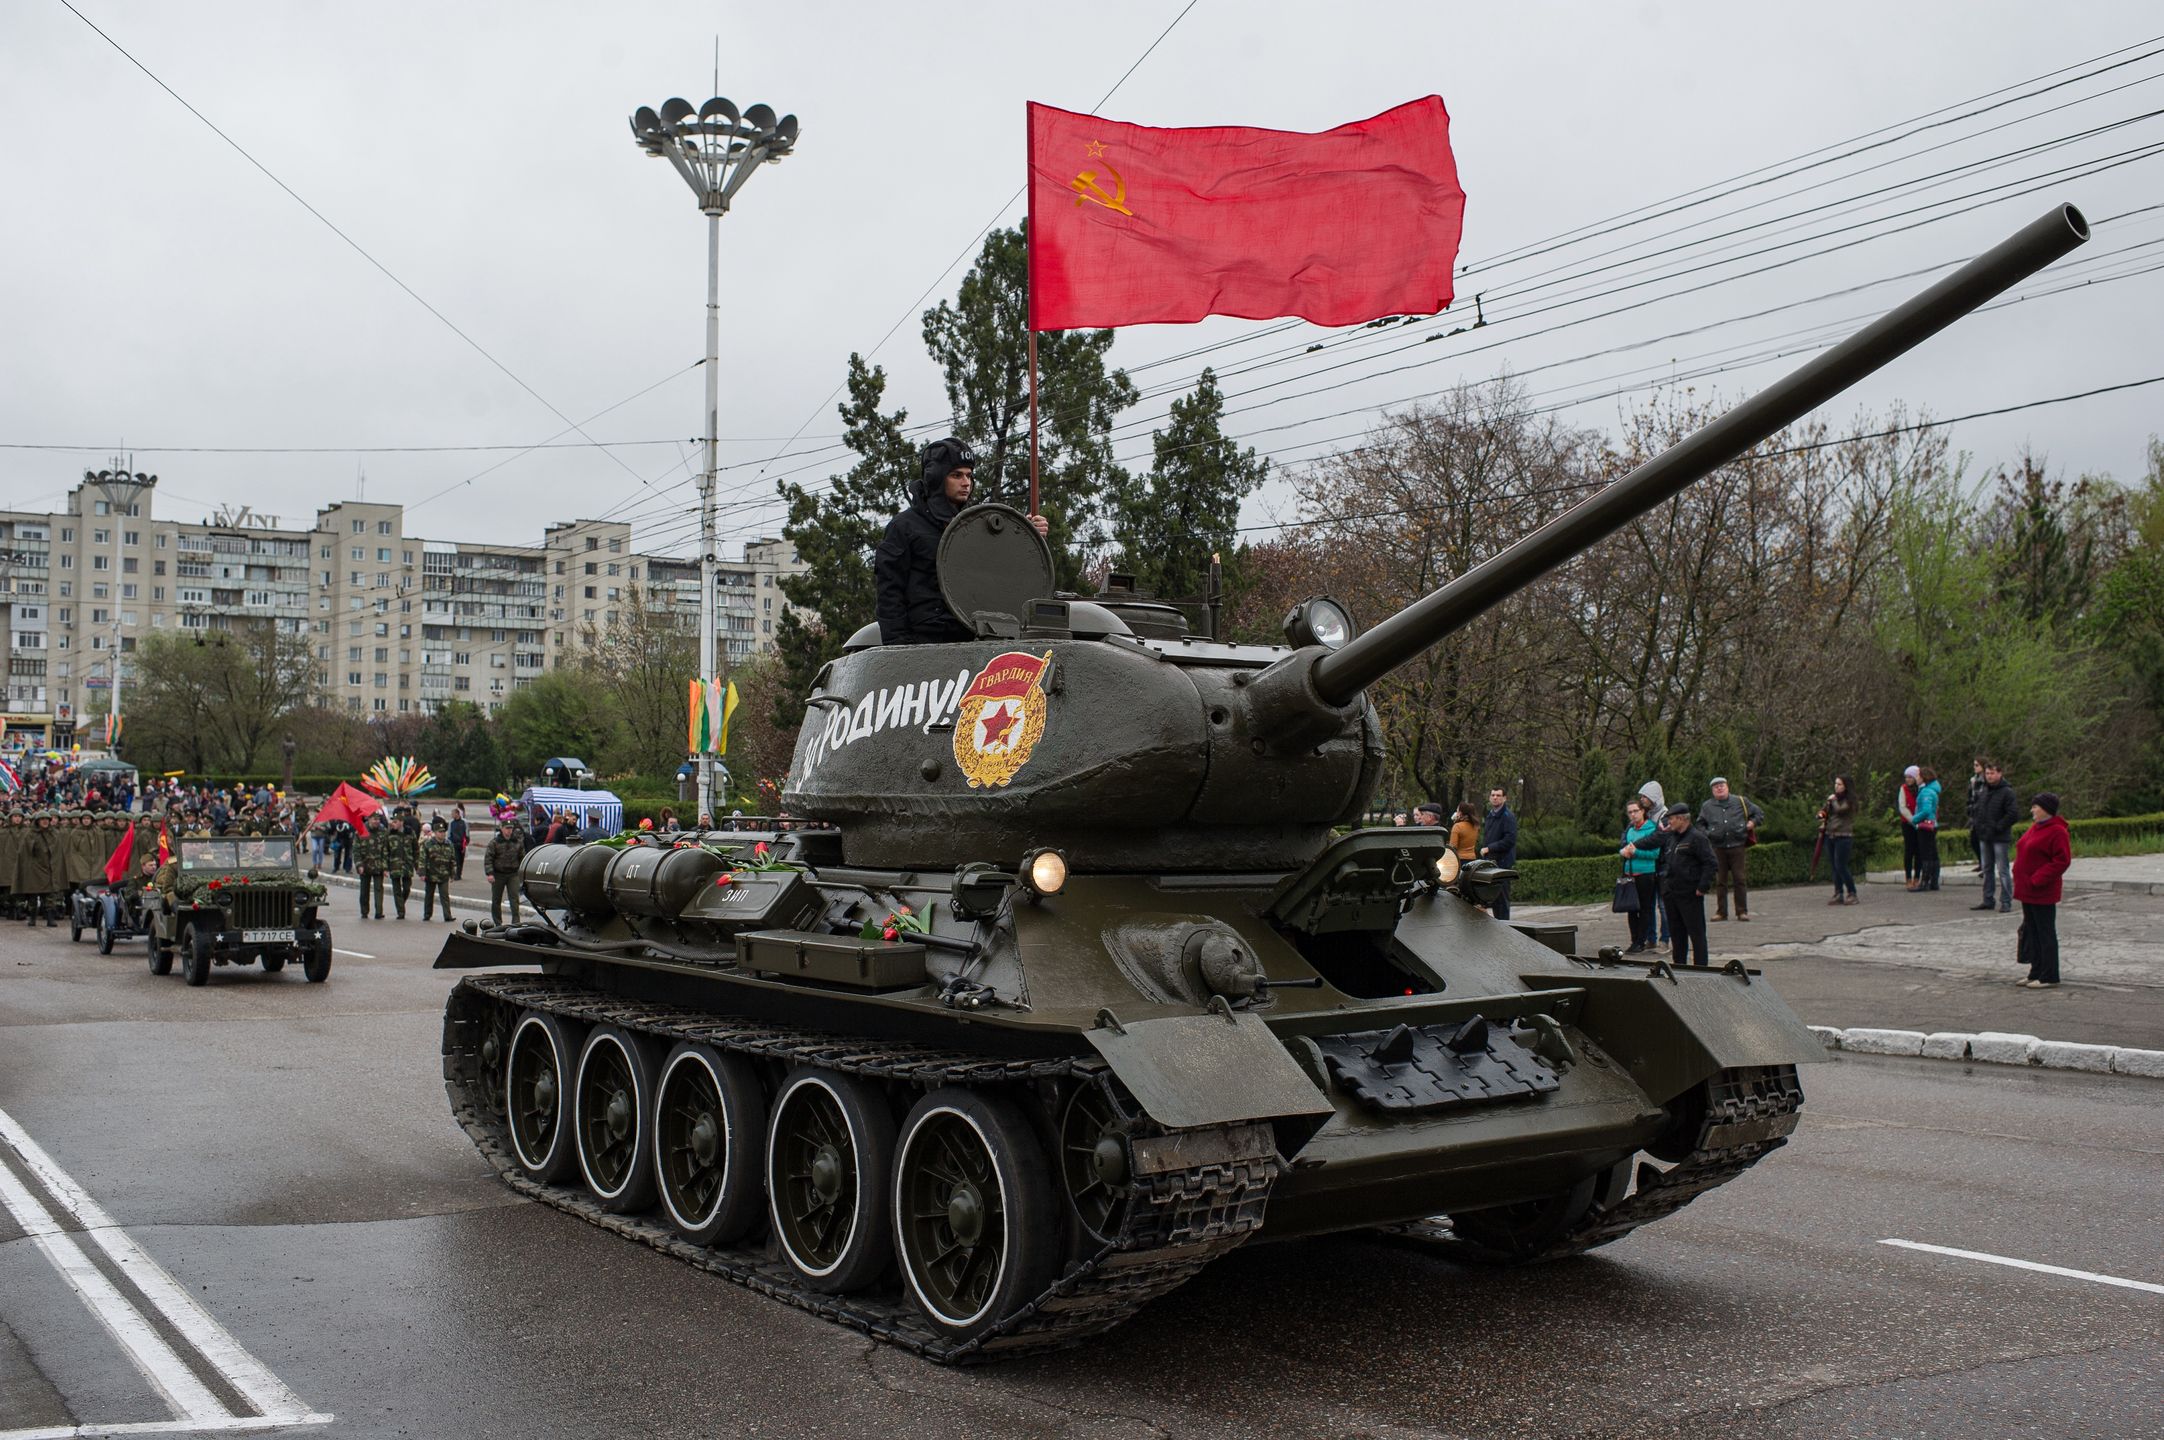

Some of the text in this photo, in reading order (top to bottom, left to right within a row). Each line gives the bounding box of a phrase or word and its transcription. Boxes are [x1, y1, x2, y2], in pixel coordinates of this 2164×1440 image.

[816, 669, 970, 767] РОДИНУ!
[536, 862, 549, 874] ДТ
[626, 865, 639, 879] ДТ
[722, 889, 749, 901] ЗИП
